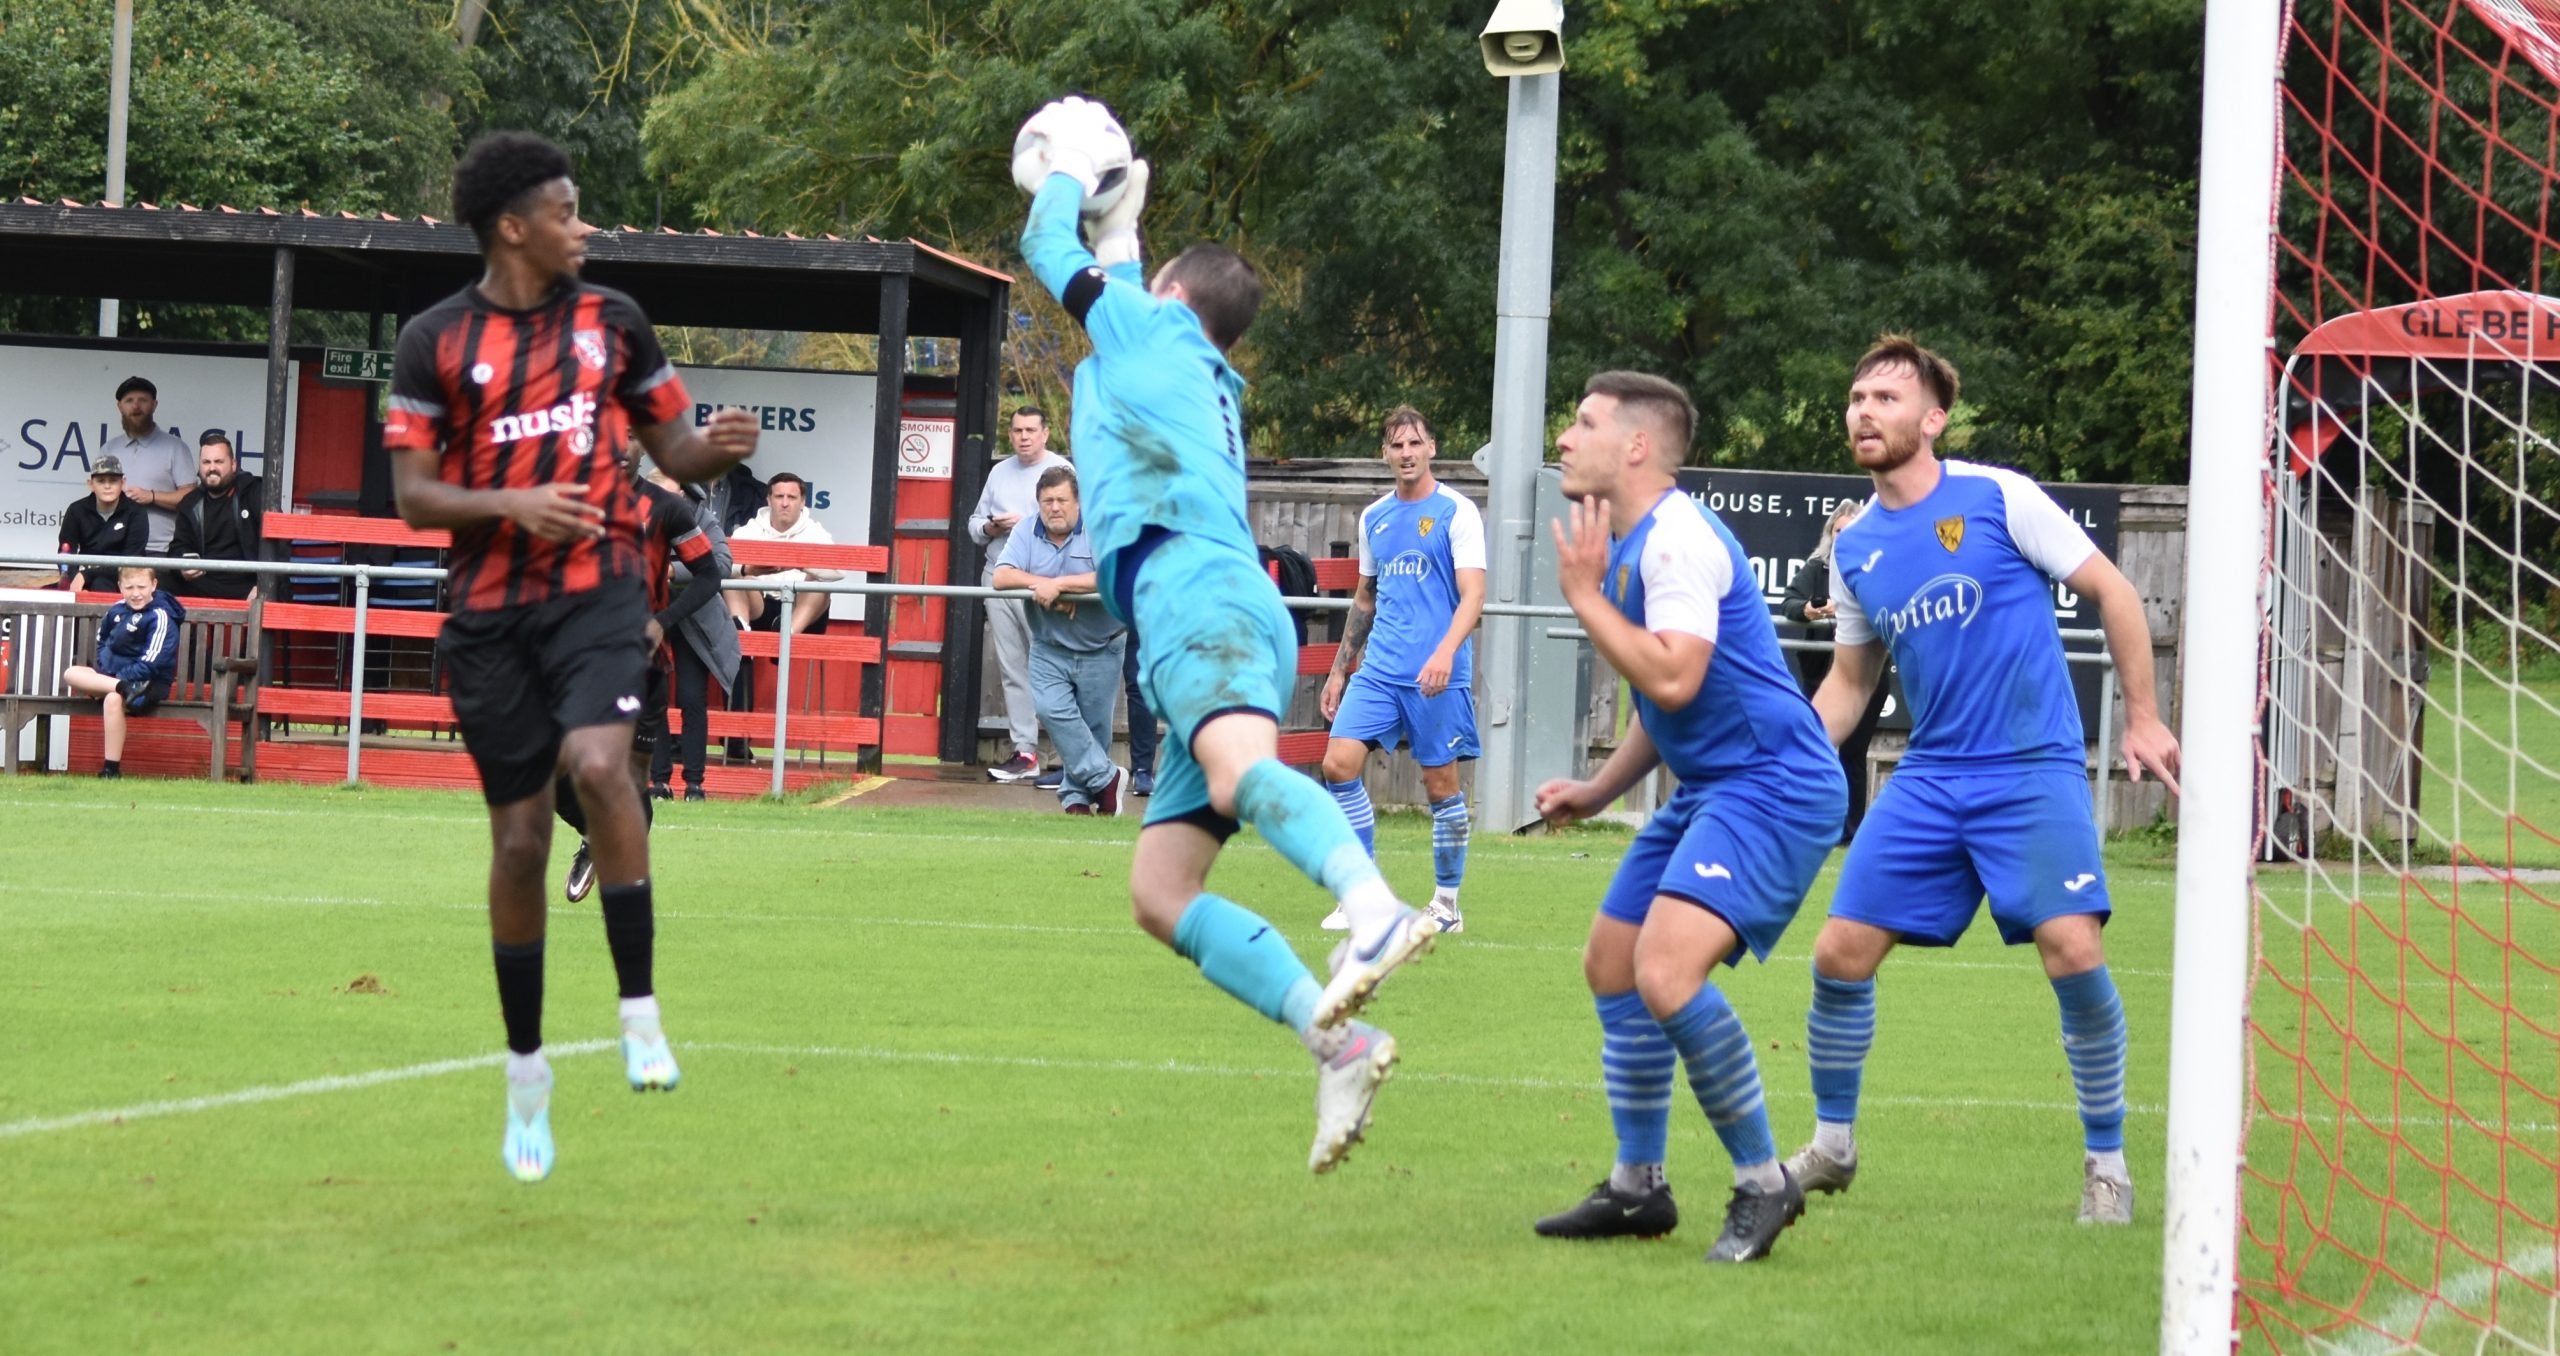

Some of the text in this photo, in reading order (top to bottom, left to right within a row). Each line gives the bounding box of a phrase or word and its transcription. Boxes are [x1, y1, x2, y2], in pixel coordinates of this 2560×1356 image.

[2402, 308, 2529, 340] GLEBE
[330, 352, 352, 362] Fire
[330, 364, 351, 374] exit
[695, 403, 816, 432] BERS
[901, 423, 951, 433] SMOKING
[906, 465, 935, 473] STAND
[1384, 557, 1423, 577] vital
[1890, 582, 1967, 634] vital
